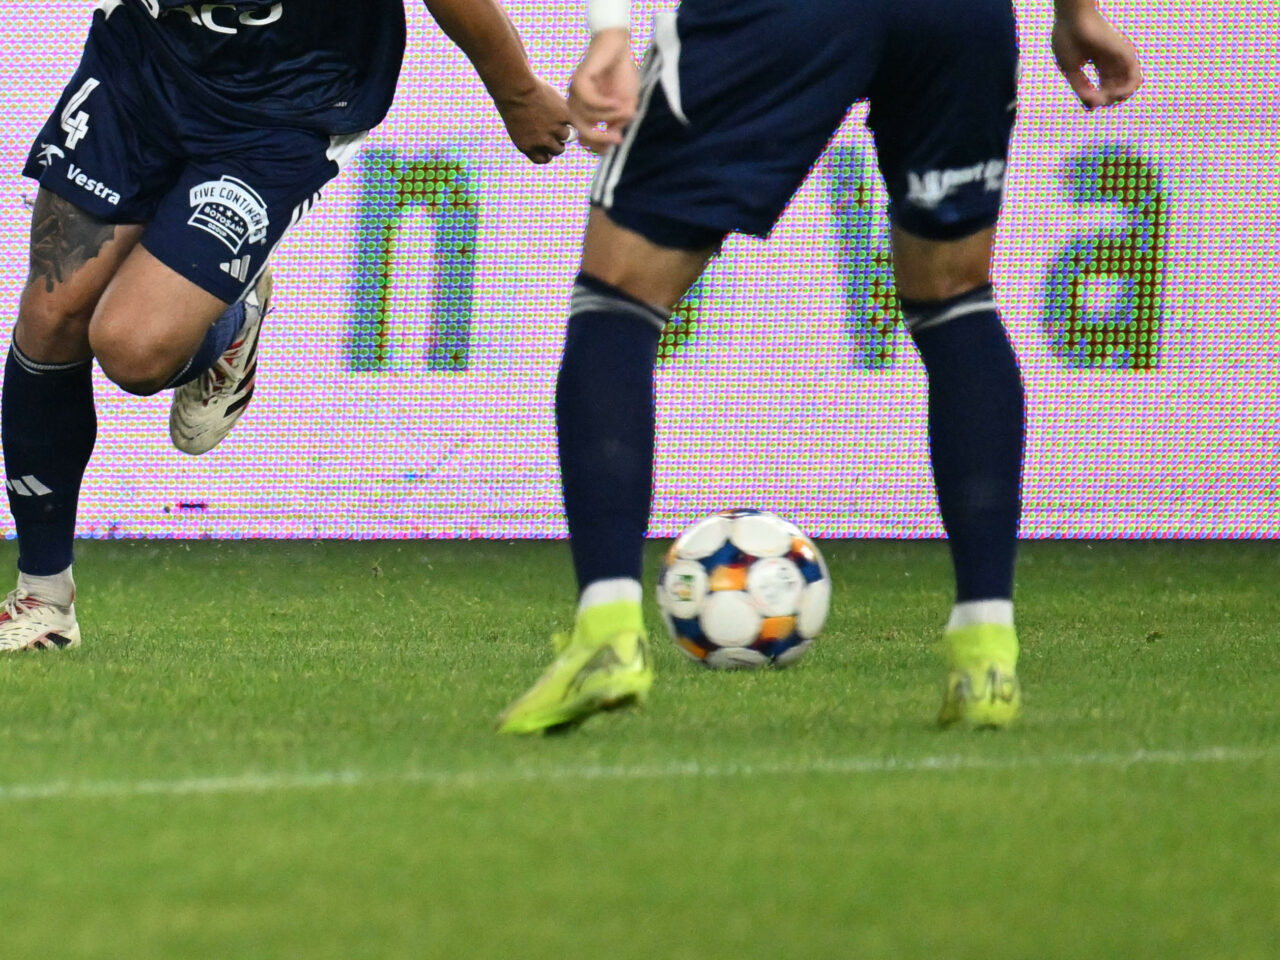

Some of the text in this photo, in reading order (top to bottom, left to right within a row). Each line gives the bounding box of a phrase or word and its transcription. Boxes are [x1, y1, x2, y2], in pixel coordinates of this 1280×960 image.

[61, 77, 101, 150] 4
[66, 163, 121, 206] Vestra
[194, 186, 216, 200] FIVE
